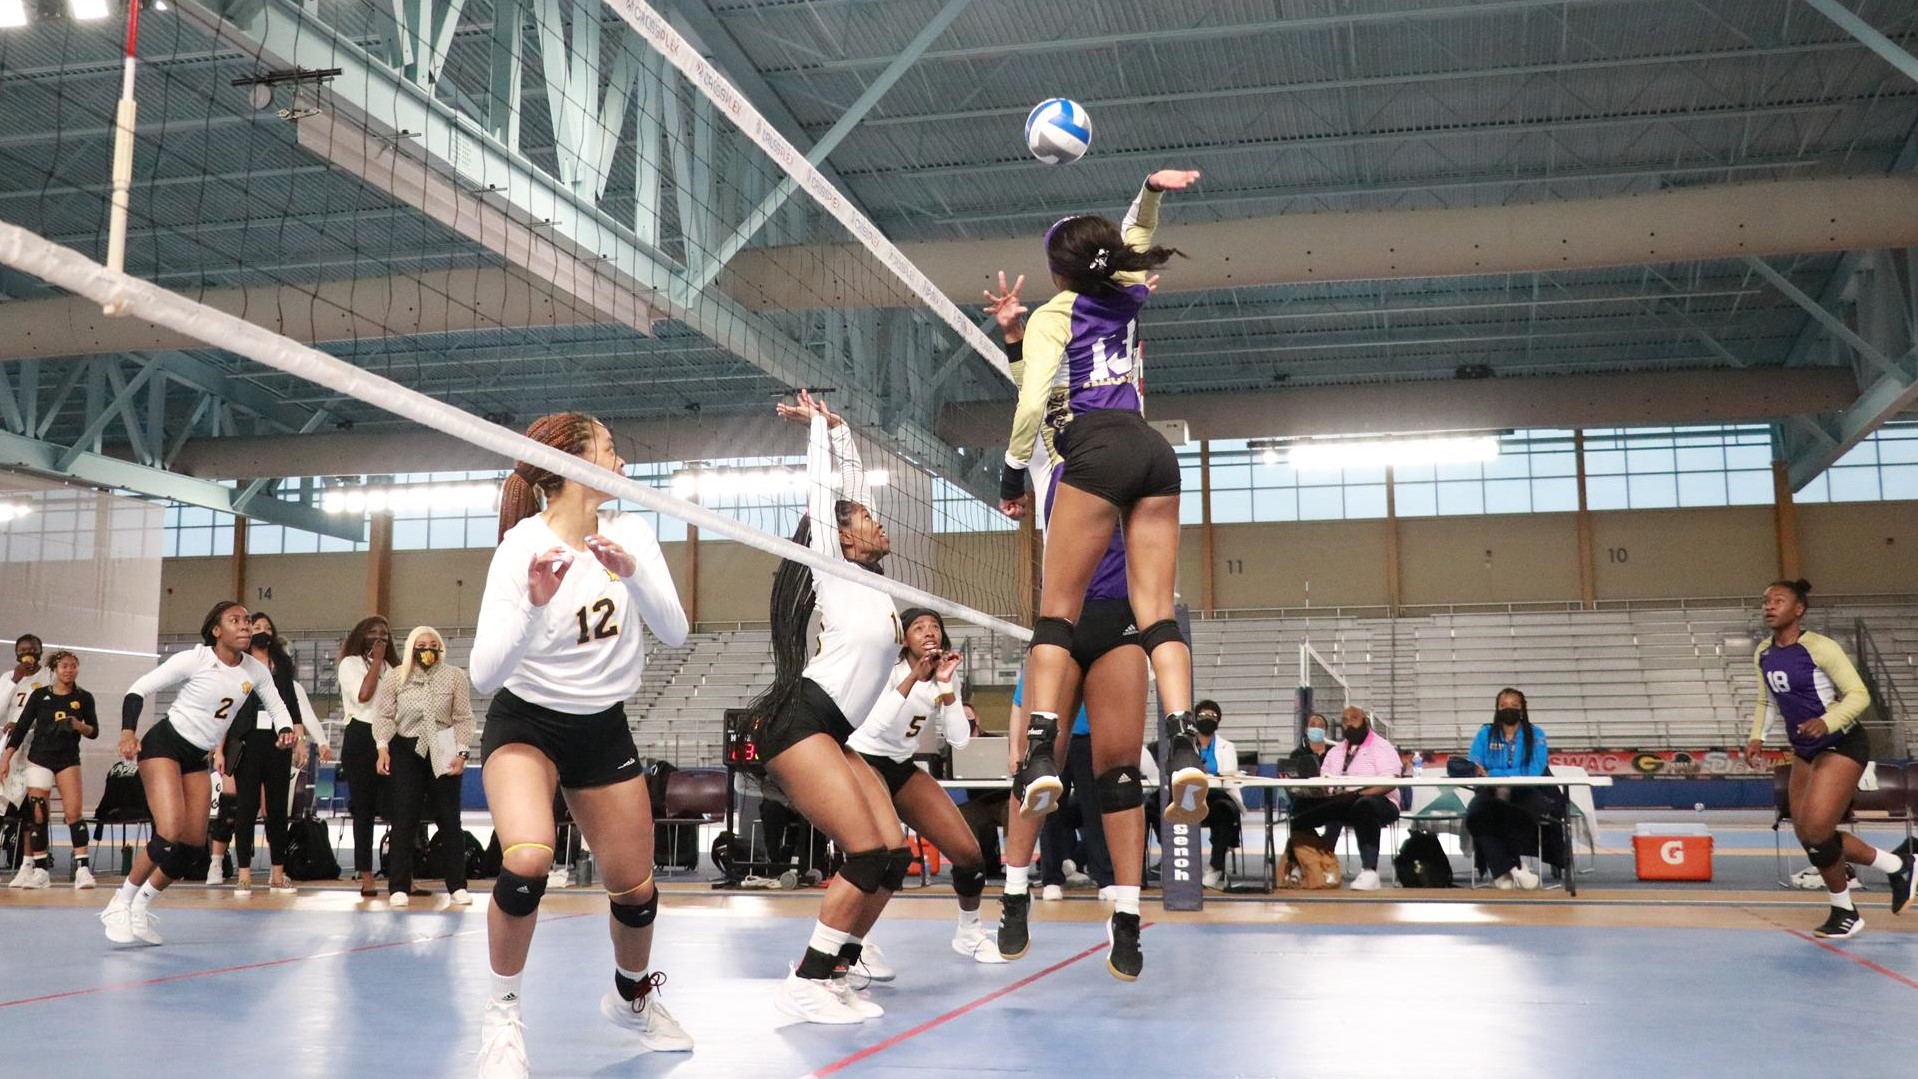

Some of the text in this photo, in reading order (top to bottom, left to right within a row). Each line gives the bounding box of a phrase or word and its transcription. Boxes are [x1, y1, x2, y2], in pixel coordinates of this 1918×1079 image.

[1608, 547, 1628, 563] 10
[1227, 559, 1243, 575] 11
[258, 587, 272, 600] 14
[576, 597, 618, 645] 12
[1766, 670, 1790, 693] 18
[17, 692, 26, 708] 7
[214, 697, 234, 719] 2
[905, 715, 927, 738] 5
[1549, 754, 1618, 772] SWAC
[1660, 840, 1685, 865] G
